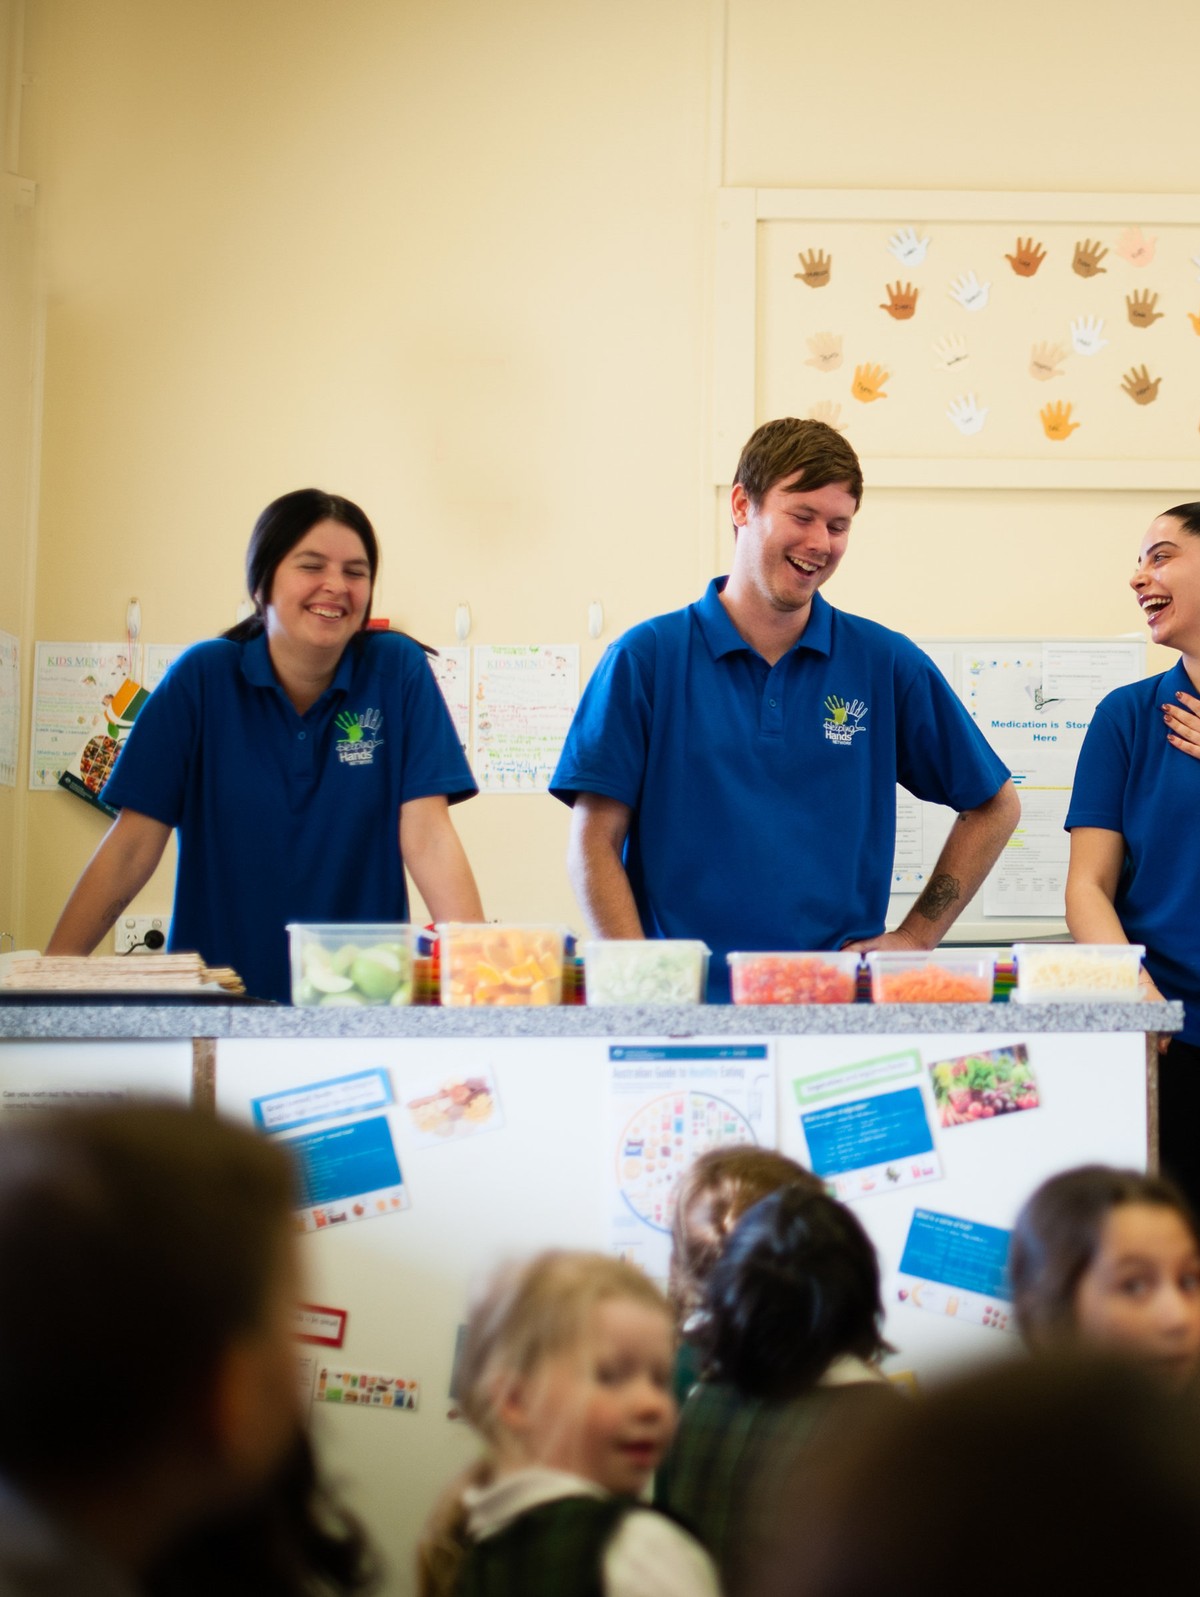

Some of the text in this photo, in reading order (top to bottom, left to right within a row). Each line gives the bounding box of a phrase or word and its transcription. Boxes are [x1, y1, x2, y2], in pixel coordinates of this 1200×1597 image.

[47, 656, 106, 667] KIDS MENU
[487, 660, 547, 670] KIDS MENU
[991, 720, 1091, 729] Medication is Store
[825, 730, 852, 741] Hands
[1032, 733, 1058, 743] Here
[339, 752, 374, 763] Hands
